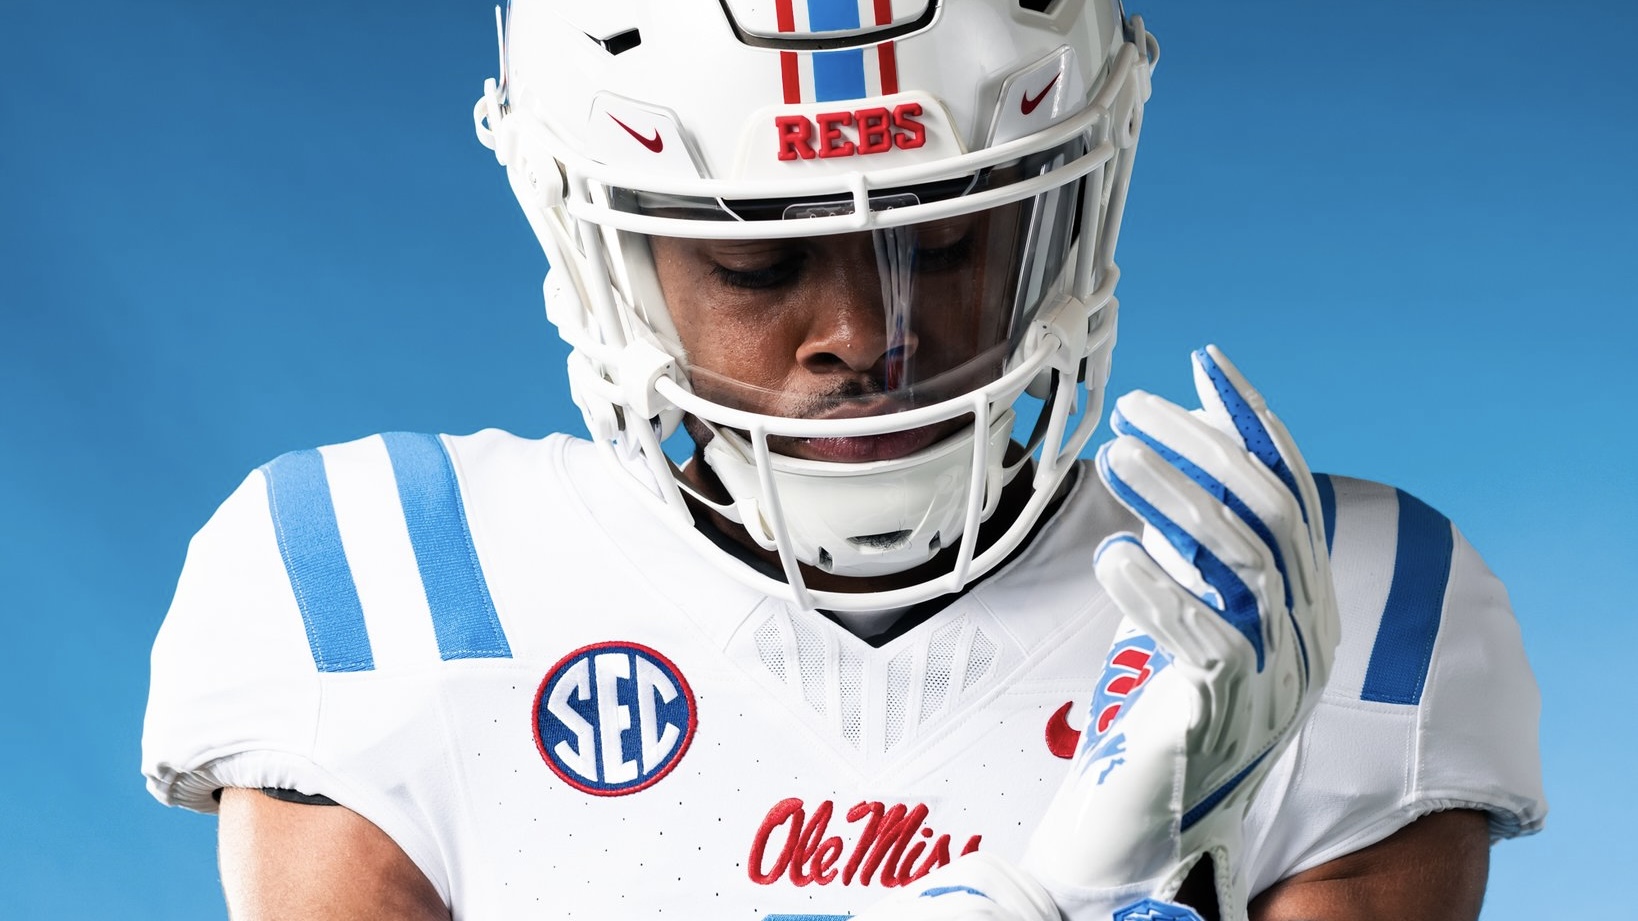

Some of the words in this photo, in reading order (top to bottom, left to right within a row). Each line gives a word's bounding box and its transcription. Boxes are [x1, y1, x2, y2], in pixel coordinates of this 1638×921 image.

[775, 102, 926, 161] REBS
[547, 652, 681, 784] SEC
[748, 797, 843, 888] Ole
[842, 800, 982, 888] Mis
